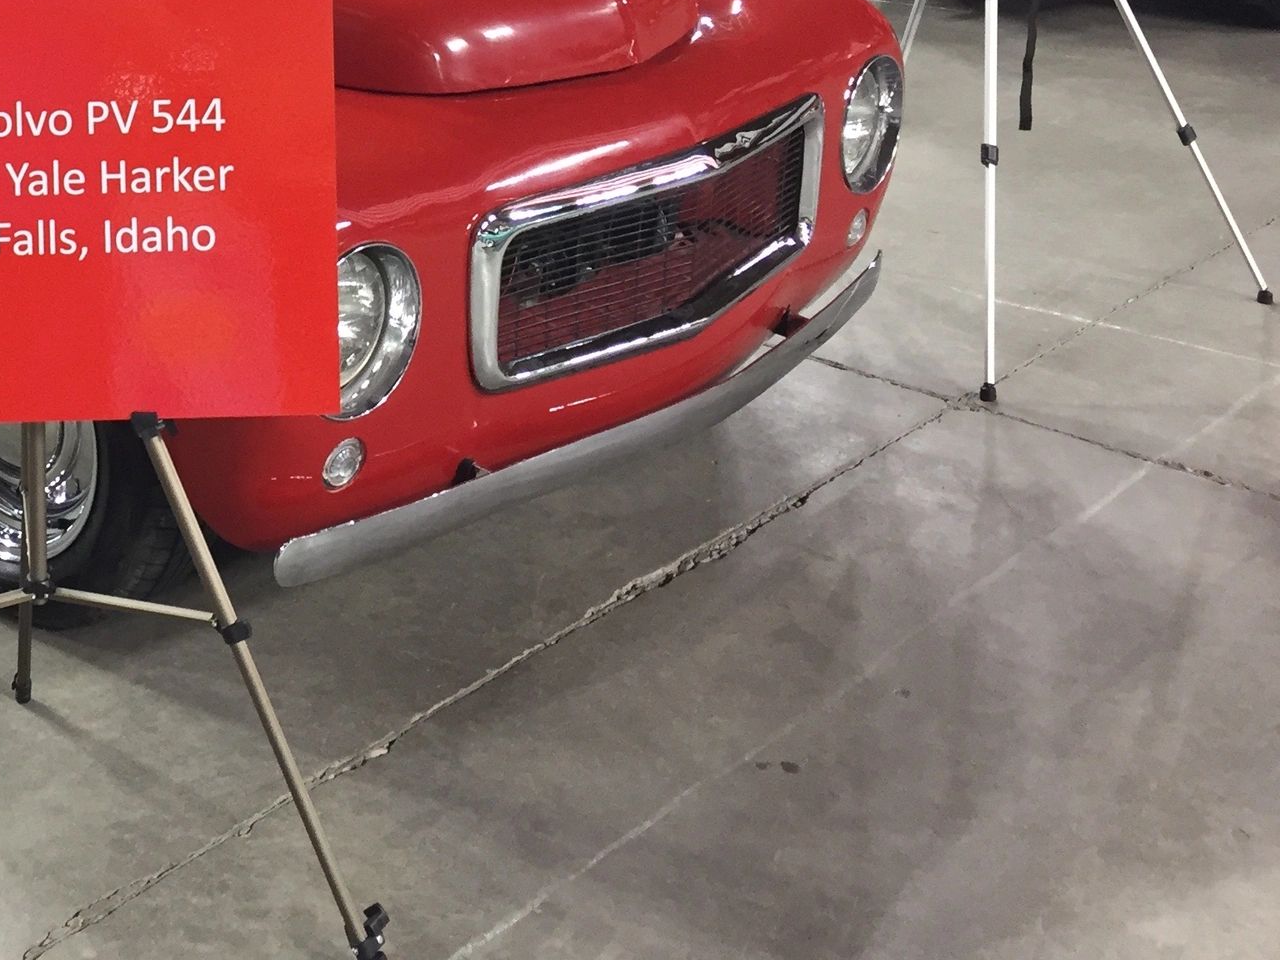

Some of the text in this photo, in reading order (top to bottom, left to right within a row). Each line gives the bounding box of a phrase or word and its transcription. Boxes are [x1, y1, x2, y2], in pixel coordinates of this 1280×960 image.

[87, 99, 139, 136] PV
[151, 97, 226, 135] 544
[5, 160, 86, 197] Yale
[101, 157, 235, 196] Harker
[103, 216, 217, 255] Idaho
